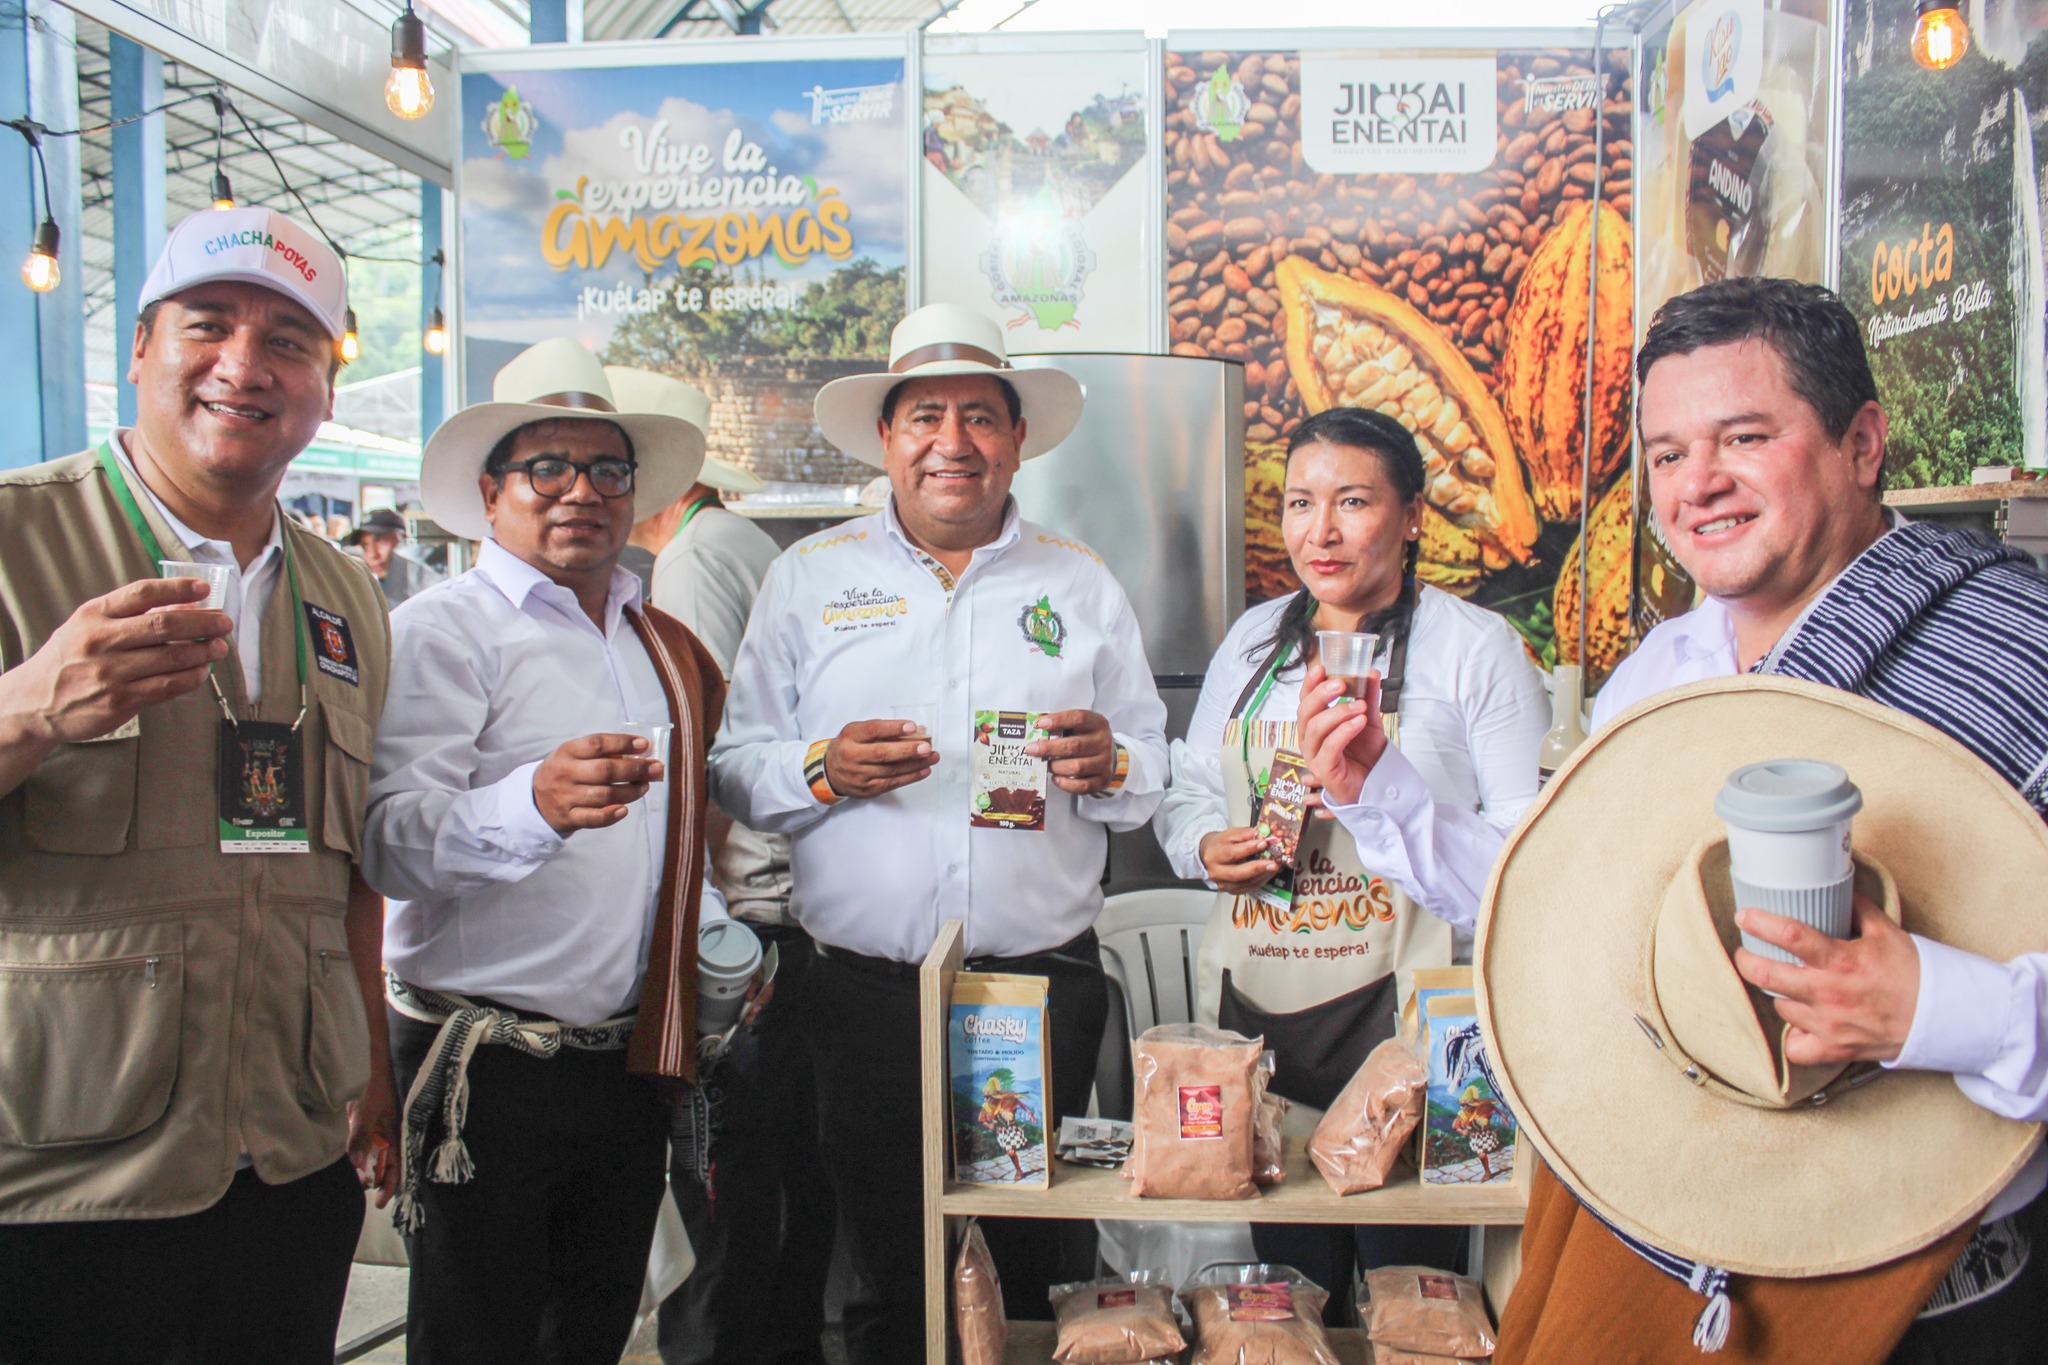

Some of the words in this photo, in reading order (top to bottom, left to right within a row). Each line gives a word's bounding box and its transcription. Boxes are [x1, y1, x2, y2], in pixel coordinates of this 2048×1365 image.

[1333, 82, 1465, 115] JINKAI
[619, 119, 713, 174] Vive
[722, 128, 767, 173] la
[1332, 120, 1466, 143] ENENTAI
[583, 166, 806, 225] experiencia
[1708, 159, 1752, 214] ANDINO
[204, 230, 317, 283] CHACHAPOYAS
[1872, 222, 1954, 305] Gocta
[1000, 293, 1077, 303] AMAZONAS
[1952, 279, 1992, 323] Bella
[843, 587, 869, 600] Vive
[872, 587, 884, 597] la
[245, 829, 286, 839] Expositor
[1309, 848, 1335, 875] la
[1294, 947, 1309, 959] te
[963, 1013, 1027, 1045] Chasky
